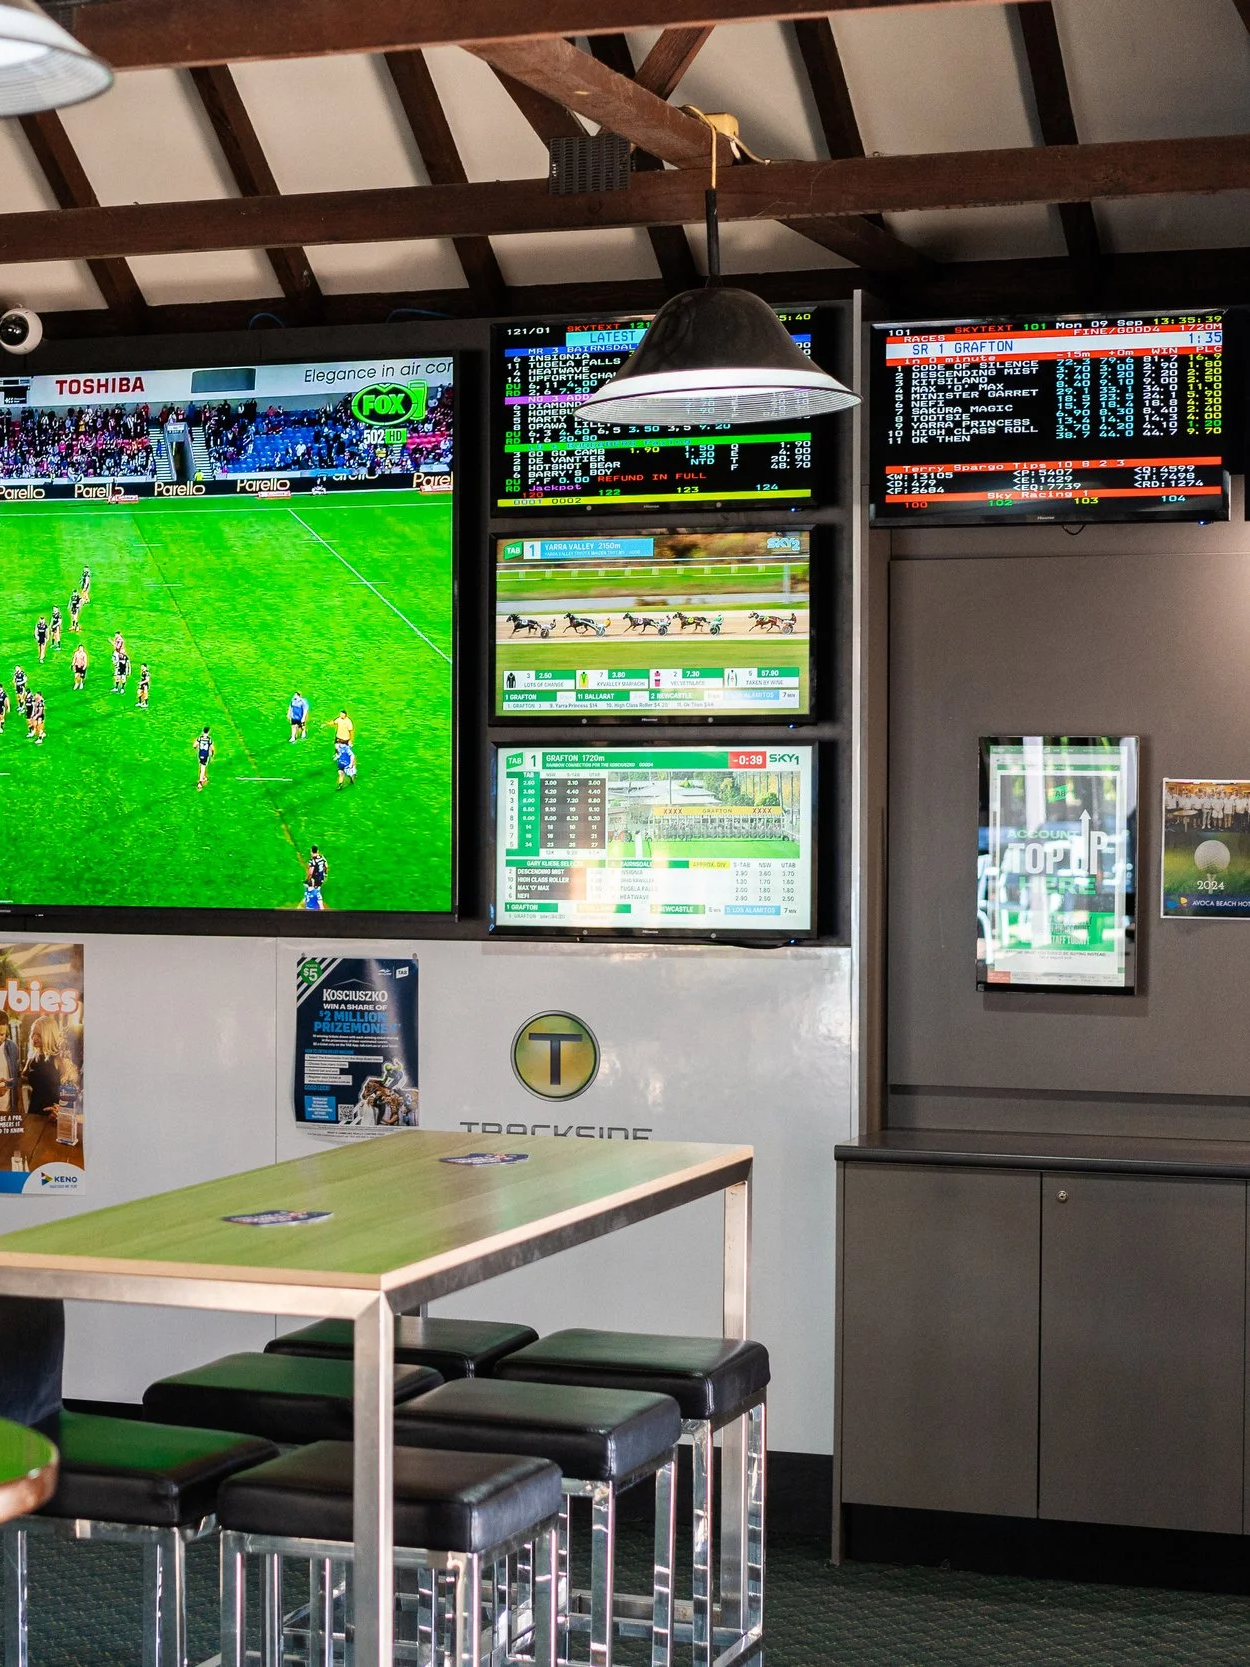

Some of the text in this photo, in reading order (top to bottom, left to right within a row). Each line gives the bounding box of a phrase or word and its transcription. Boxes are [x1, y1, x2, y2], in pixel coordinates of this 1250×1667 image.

[507, 327, 550, 335] 121/01
[955, 325, 1013, 333] SKYTEXT
[1154, 316, 1222, 325] 13:35:39
[590, 331, 636, 343] LATEST
[904, 323, 1222, 343] RACES FINE/GOOD4 1720M
[913, 332, 1222, 355] SR 1 GRAFTON 1:35
[529, 353, 590, 361] INSIGNIA
[528, 367, 590, 375] HEATWAVE
[980, 361, 1038, 369] SILENCE
[305, 368, 376, 384] Elegance
[382, 364, 394, 377] in
[400, 363, 420, 375] air
[912, 370, 996, 378] DESCENDING
[56, 377, 144, 395] TOSHIBA
[912, 377, 988, 385] KITSILANO
[362, 394, 404, 415] FOX
[962, 419, 1030, 427] PRINCESS
[364, 430, 402, 444] 502 HD
[528, 463, 582, 471] HOTSHOT
[154, 481, 206, 496] Parello
[236, 478, 290, 493] Parello
[529, 544, 535, 557] 1
[531, 756, 536, 767] 1
[546, 754, 578, 762] GRAFTON
[582, 754, 605, 762] 1720m
[1007, 829, 1080, 839] ACCOUNT
[1007, 842, 1064, 874] TOP
[1019, 877, 1096, 895] HERE
[1197, 881, 1224, 890] 2024
[303, 968, 317, 981] $5
[323, 989, 388, 1002] KOSCIUSZKO
[319, 1011, 387, 1022] $2 MILLION
[529, 1033, 582, 1085] T
